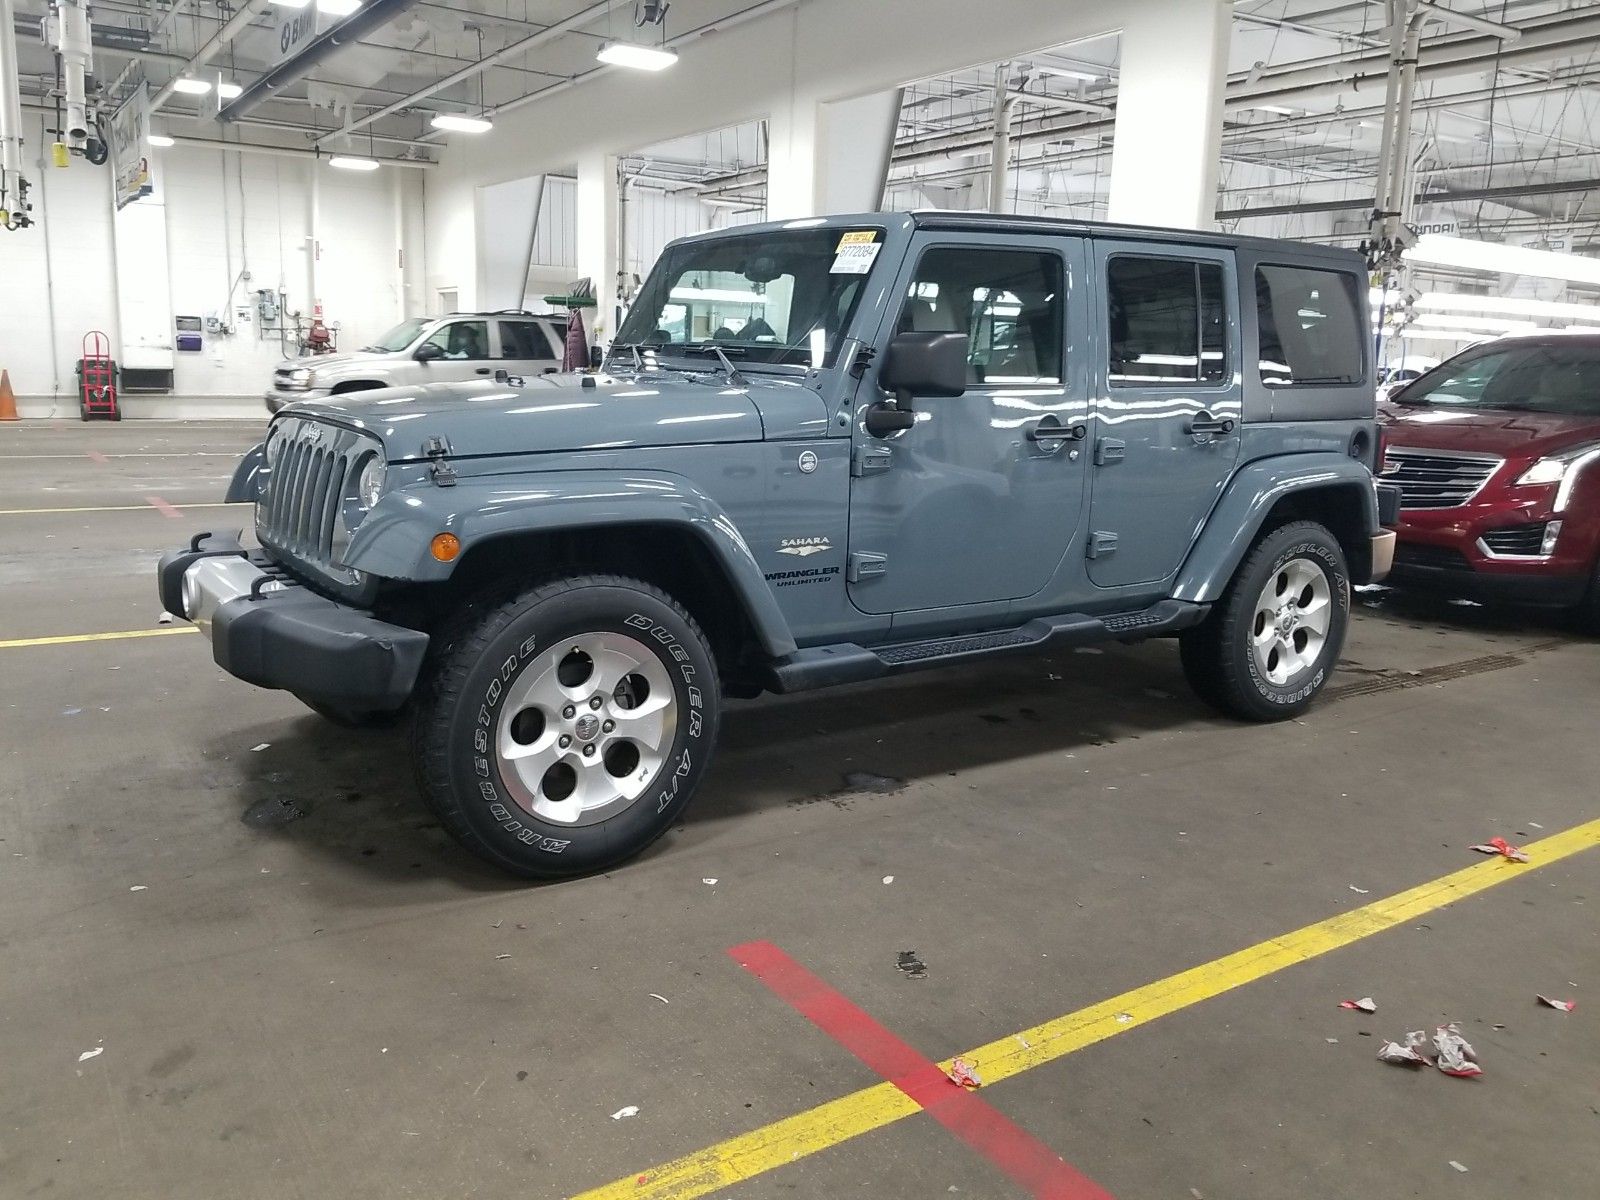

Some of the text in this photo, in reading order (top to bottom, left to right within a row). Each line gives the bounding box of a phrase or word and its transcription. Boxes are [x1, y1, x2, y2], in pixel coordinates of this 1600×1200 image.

[781, 536, 830, 547] SAHARA
[764, 566, 840, 581] WRANGLER
[776, 576, 832, 587] UNLIMITED
[623, 612, 705, 815] DUELER A/T
[474, 634, 572, 855] BRIDGESTONE
